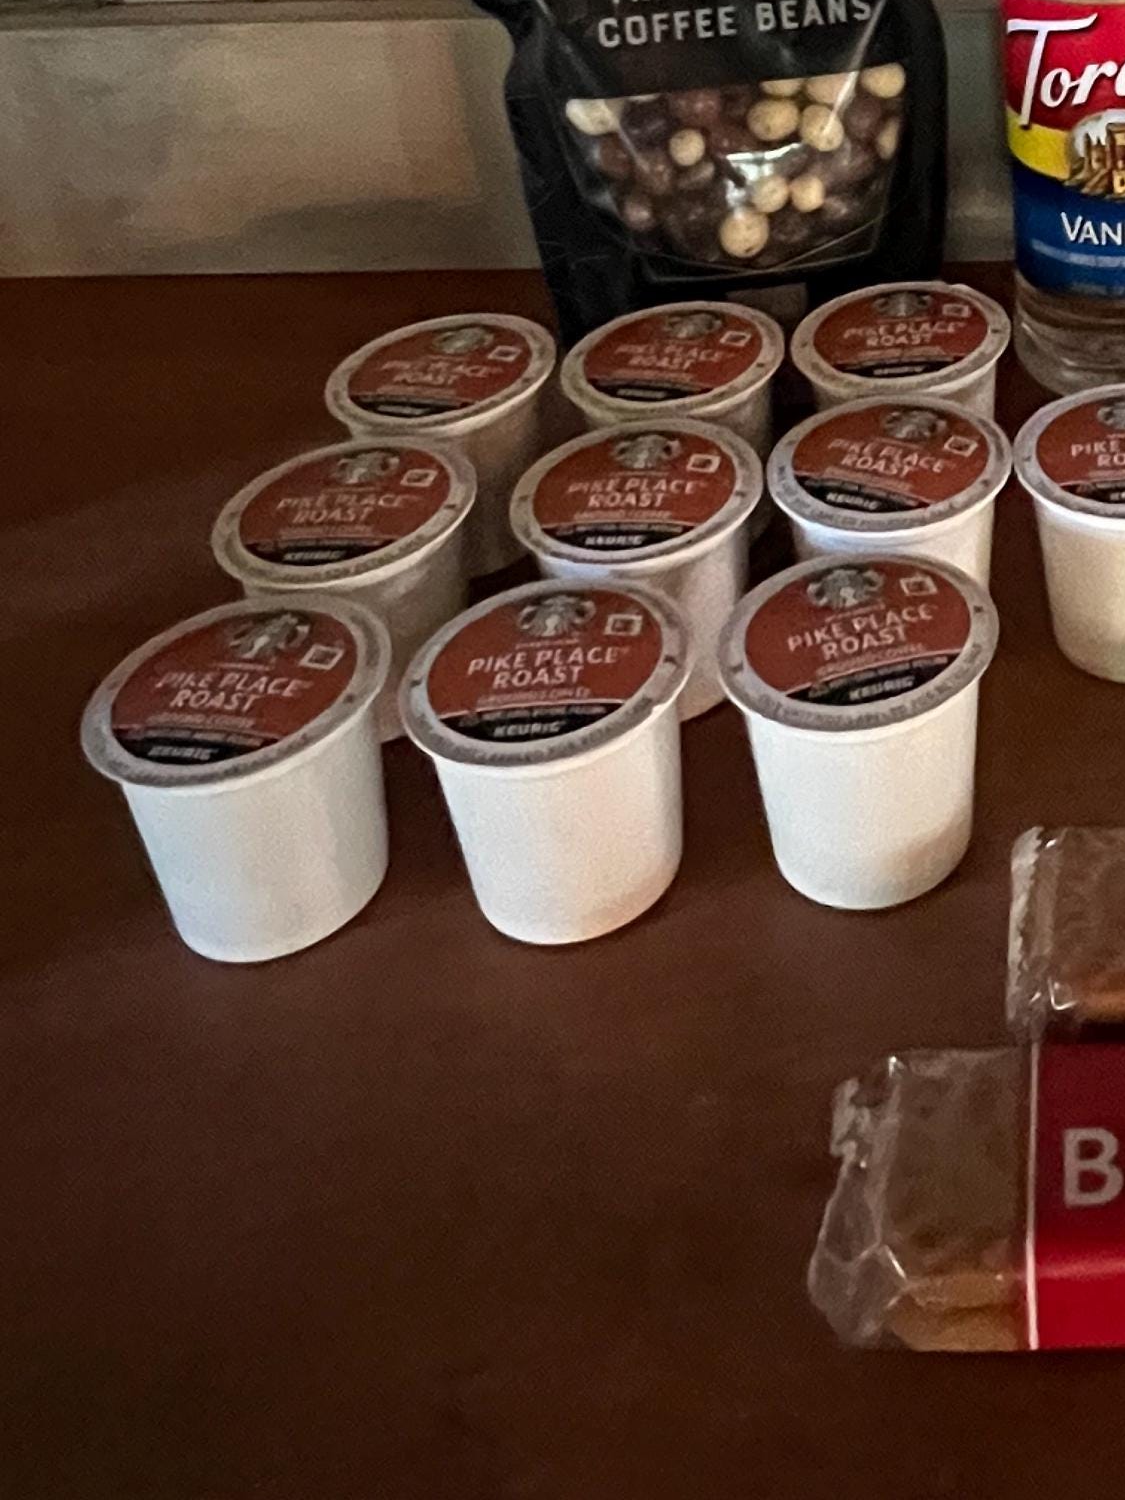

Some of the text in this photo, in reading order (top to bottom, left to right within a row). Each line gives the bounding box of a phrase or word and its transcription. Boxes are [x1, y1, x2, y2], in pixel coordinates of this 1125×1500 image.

[599, 6, 738, 48] COFFEE
[827, 439, 875, 456] PIKE
[880, 447, 944, 474] PLACE
[1071, 439, 1122, 457] PIKE
[841, 454, 912, 476] ROAST
[567, 477, 699, 495] PIKE PLACE
[588, 492, 667, 508] ROAST
[787, 620, 844, 651] PIKE
[851, 604, 933, 633] PLACE
[821, 625, 907, 660] ROAST
[468, 647, 620, 675] PIKE PLACE
[155, 671, 301, 698] PIKE PLACE
[492, 665, 585, 690] ROAST
[170, 689, 261, 711] ROAST
[493, 721, 563, 738] KEURIG
